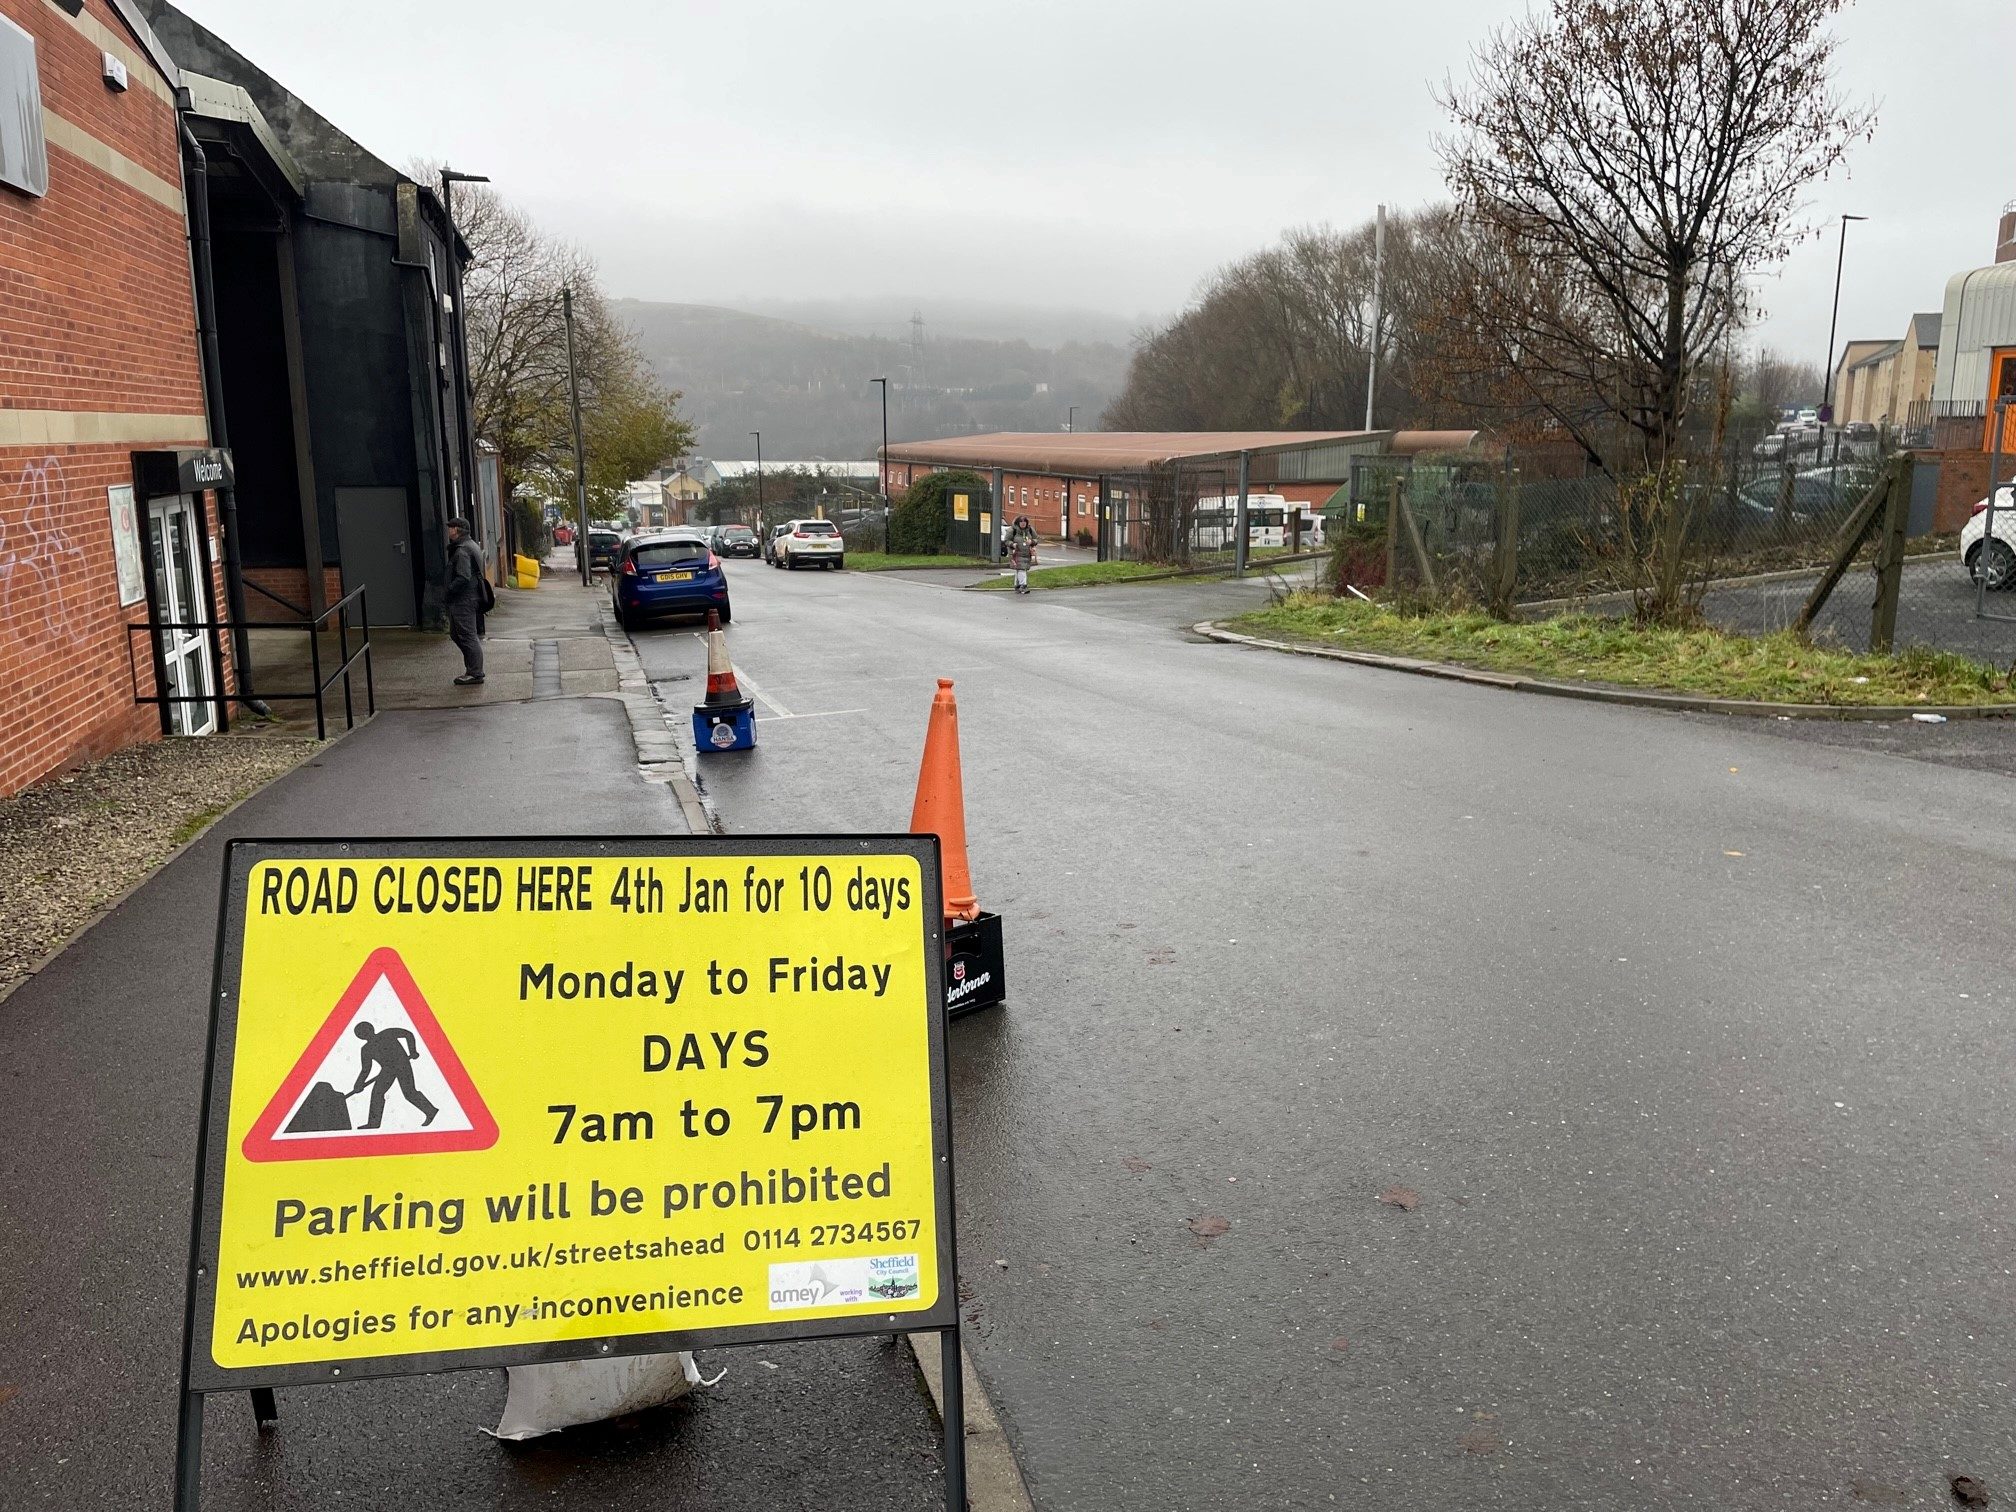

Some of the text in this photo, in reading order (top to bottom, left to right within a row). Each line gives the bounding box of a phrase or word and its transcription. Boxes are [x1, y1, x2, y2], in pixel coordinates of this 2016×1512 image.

[193, 457, 223, 482] Welcome
[261, 865, 911, 920] ROAD CLOSED HERE 4th Jan for 10 days
[519, 955, 892, 1005] Monday to Friday
[643, 1029, 769, 1073] DAYS
[547, 1094, 861, 1145] 7am to 7pm
[274, 1162, 891, 1238] Parking will be prohibited
[236, 1219, 921, 1290] www.sheffield.gov.uk/streetsahead 0114 2734567
[870, 1256, 914, 1269] Sheffield
[236, 1285, 743, 1348] Apologies for any inconvenience
[770, 1288, 819, 1304] amey
[840, 1288, 863, 1297] working
